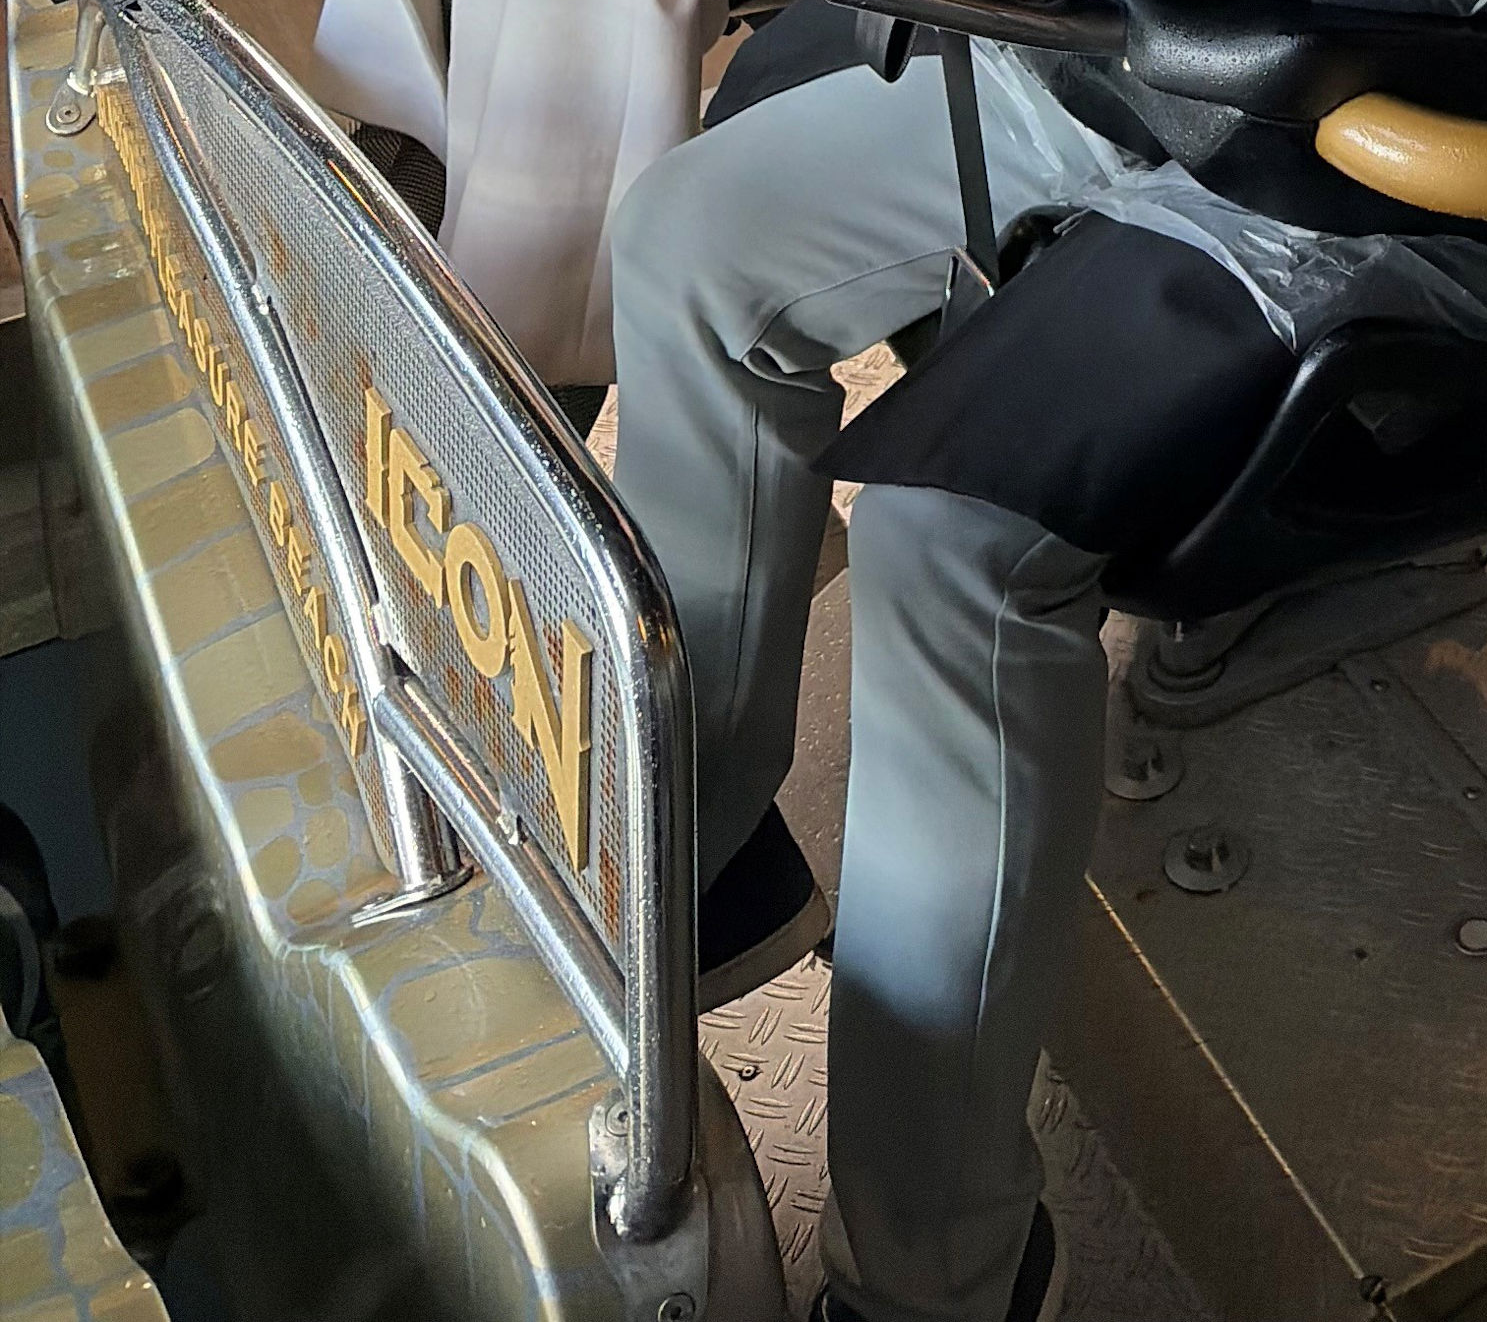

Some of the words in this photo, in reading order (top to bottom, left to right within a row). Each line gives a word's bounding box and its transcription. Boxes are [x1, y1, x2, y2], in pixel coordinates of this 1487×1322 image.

[149, 210, 267, 487] PLEASURE
[269, 480, 366, 757] BEACH
[365, 386, 592, 872] ICON
